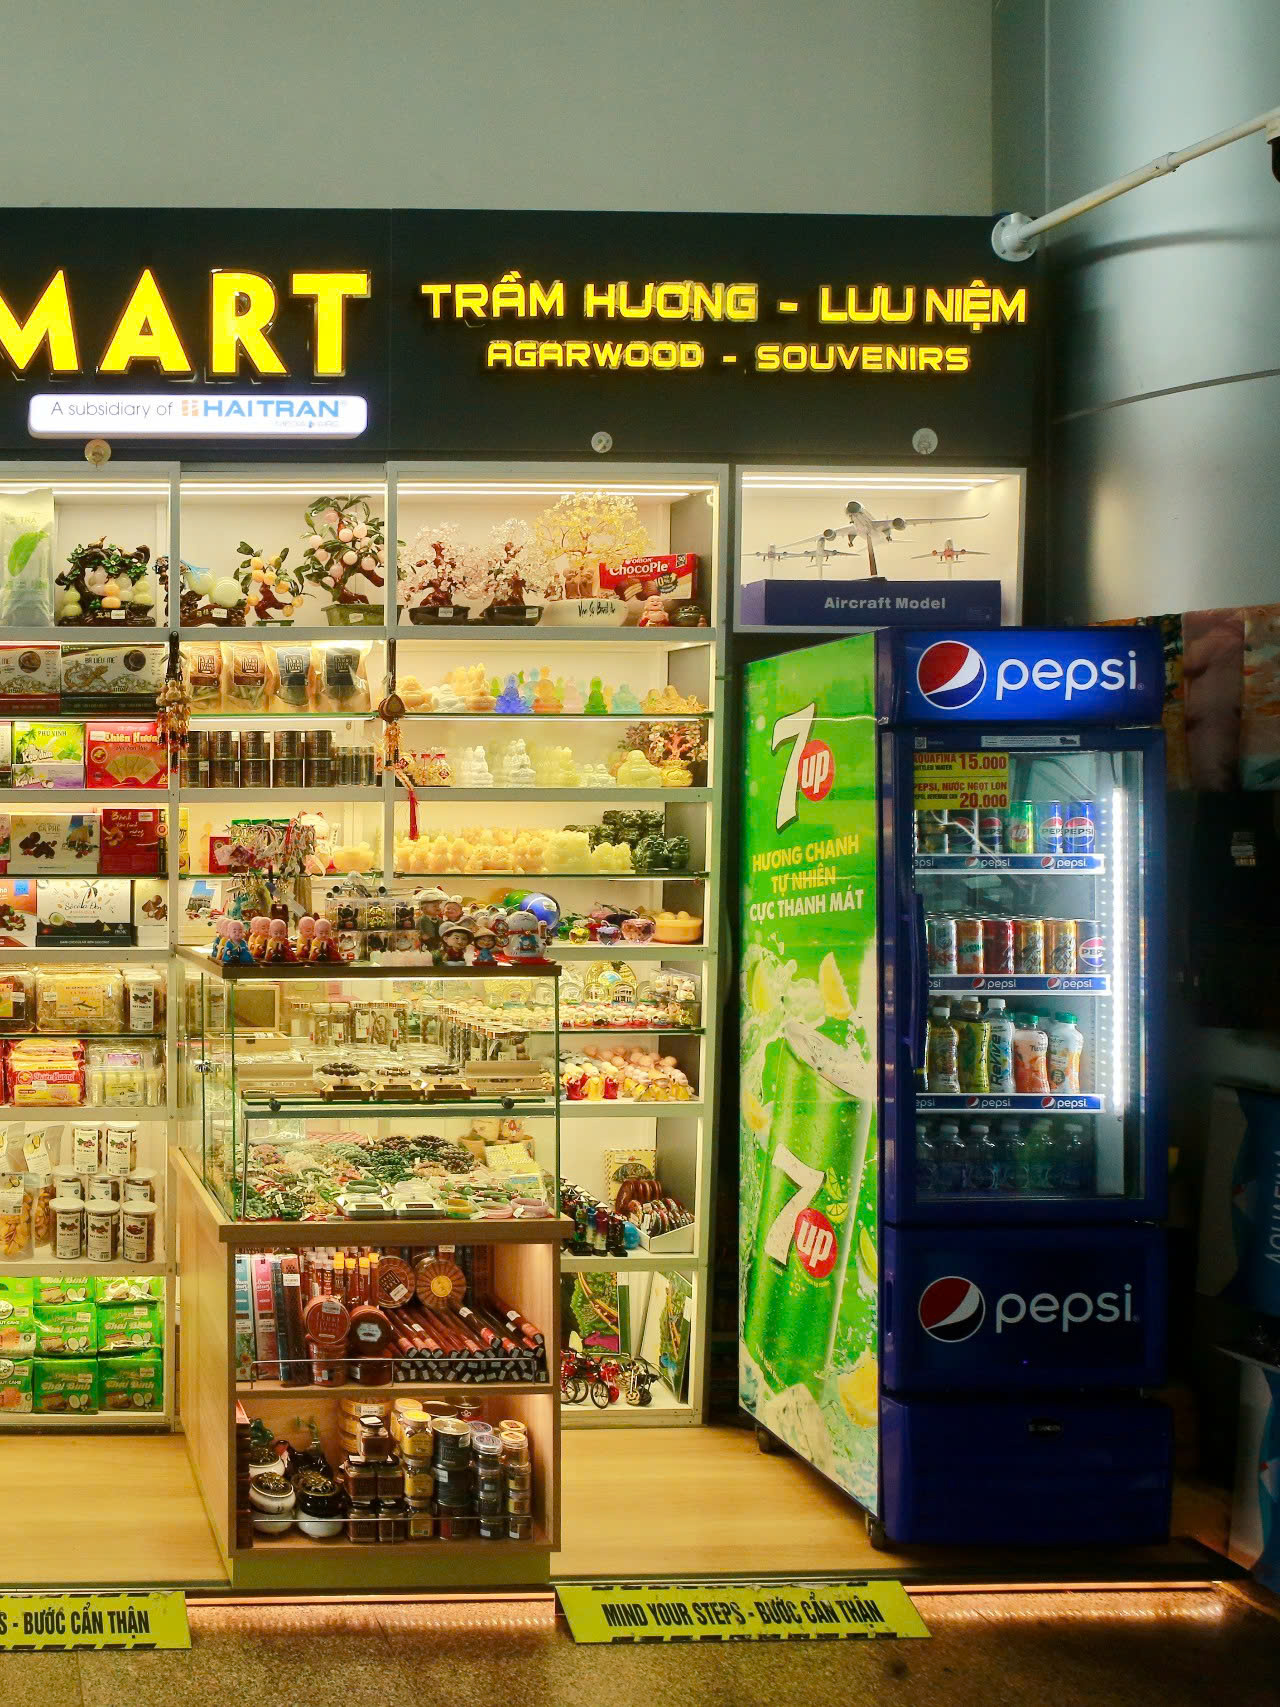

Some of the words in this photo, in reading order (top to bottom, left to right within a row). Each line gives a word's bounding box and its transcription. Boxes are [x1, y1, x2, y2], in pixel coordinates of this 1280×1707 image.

[421, 270, 564, 320] TRẦM
[586, 281, 757, 322] HƯƠNG
[821, 284, 912, 323] LƯU
[925, 279, 1026, 332] NIỆM
[487, 341, 704, 370] AGARWOOD
[757, 344, 969, 372] SOUVENIRS
[51, 402, 64, 416] A
[68, 402, 150, 420] subsidiary
[156, 402, 173, 416] of
[824, 597, 891, 609] Aircraft
[896, 597, 946, 609] Model
[997, 651, 1138, 700] pepsi
[960, 753, 1006, 769] 15.000
[991, 782, 1007, 790] LON
[752, 843, 803, 872] HƯƠNG
[805, 835, 859, 864] CHANH
[982, 858, 1010, 869] pepsi
[1057, 858, 1087, 869] pepsi
[792, 862, 836, 891] NHIÊN
[777, 894, 827, 918] THANH
[830, 888, 864, 911] MÁT
[988, 980, 1016, 989] pepsi
[1063, 979, 1092, 989] pepsi
[982, 1099, 1010, 1109] pepsi
[1058, 1099, 1087, 1109] pepsi
[996, 1284, 1133, 1334] pepsi
[602, 1603, 648, 1627] MIND
[647, 1603, 693, 1626] YOUR
[696, 1602, 745, 1625] STEPS
[754, 1597, 802, 1624] BƯỚC
[802, 1592, 835, 1623] CẨN
[837, 1595, 885, 1629] THẬN
[24, 1606, 66, 1635] BƯỚC
[71, 1602, 103, 1635] CẨN
[108, 1605, 150, 1639] THẬN
